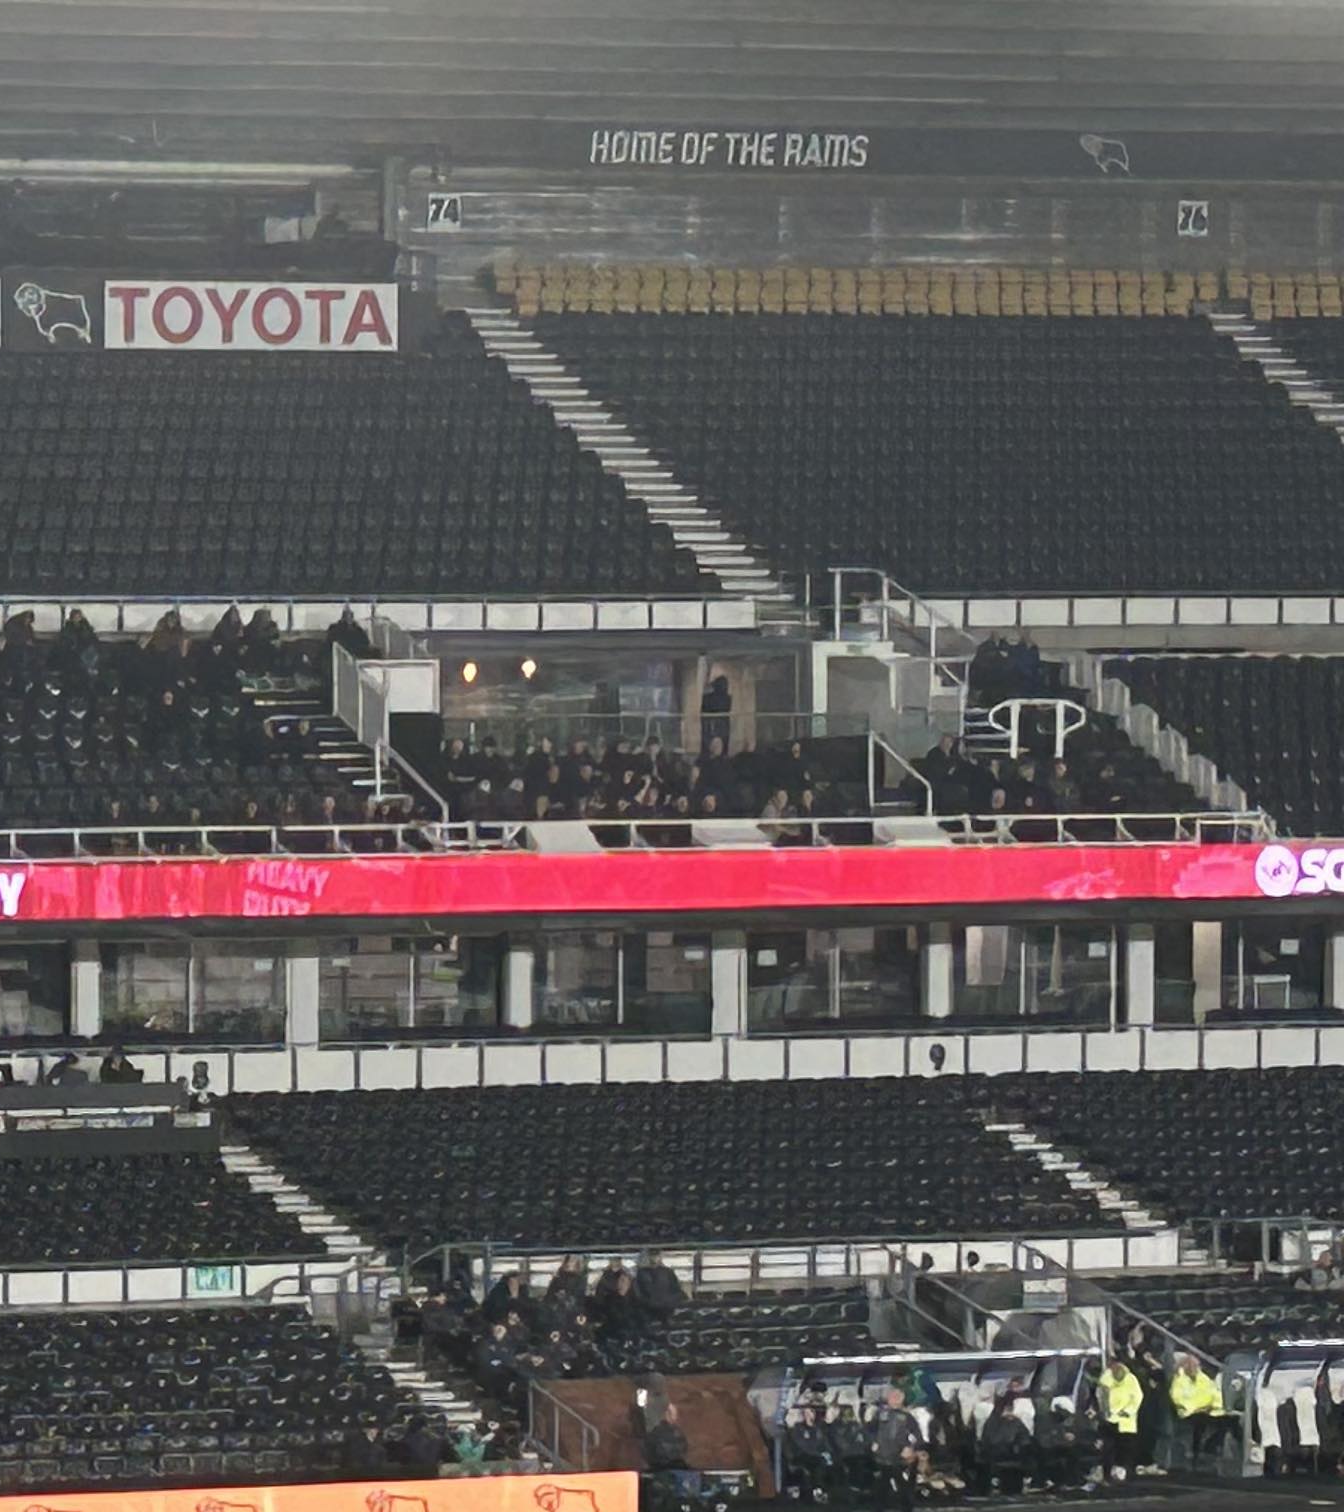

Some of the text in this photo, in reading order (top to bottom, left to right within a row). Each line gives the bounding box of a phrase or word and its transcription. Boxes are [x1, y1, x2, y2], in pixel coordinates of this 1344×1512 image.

[590, 130, 869, 168] HOME OF THE RAMS
[107, 286, 393, 346] TOYOTA
